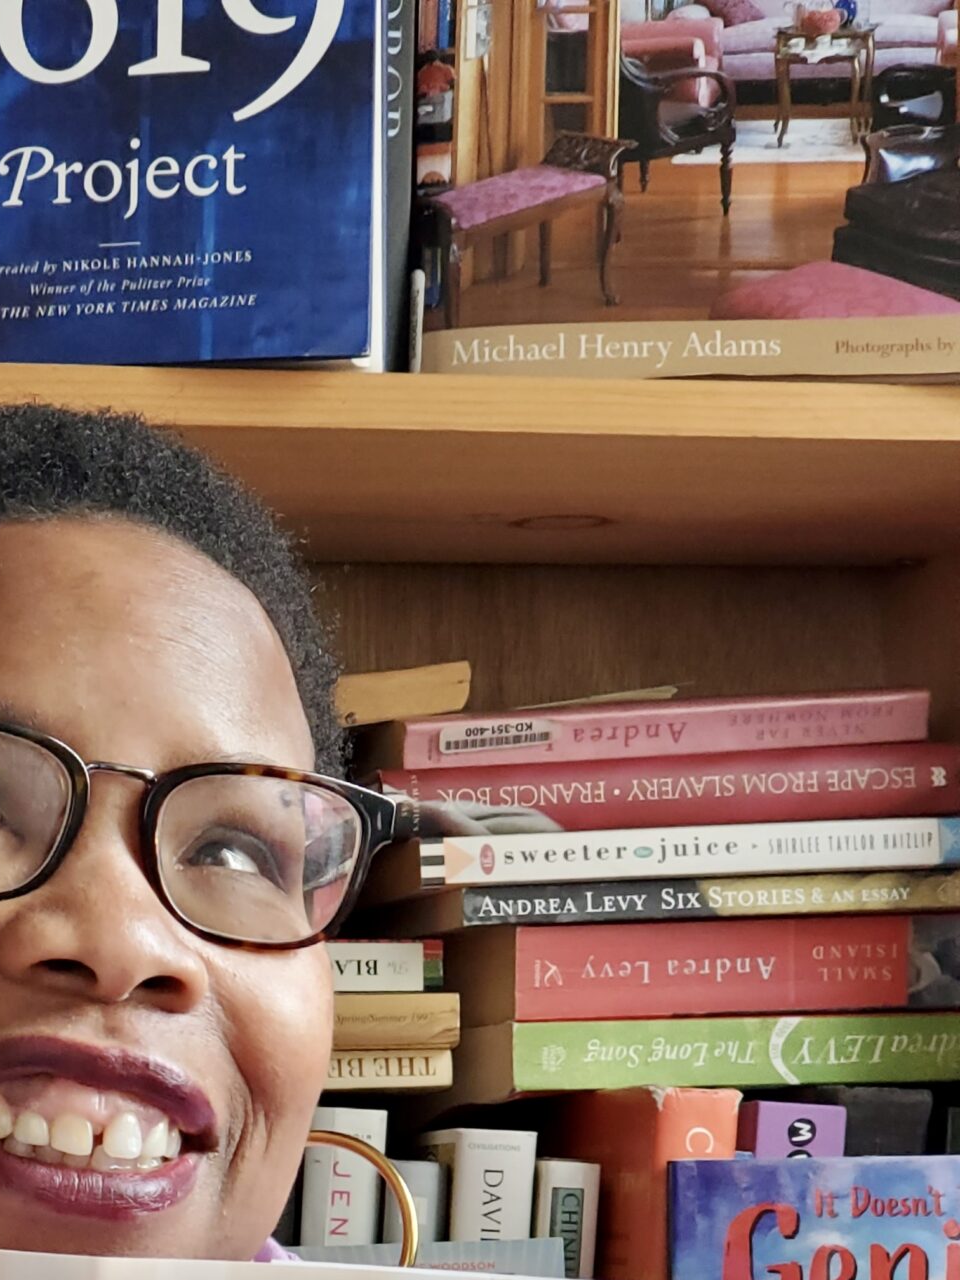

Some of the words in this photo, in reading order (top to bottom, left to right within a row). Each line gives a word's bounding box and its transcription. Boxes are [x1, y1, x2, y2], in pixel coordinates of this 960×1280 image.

[43, 261, 58, 276] by
[62, 257, 120, 272] NIKOLE
[127, 250, 253, 268] HANNAH-JONES
[30, 282, 76, 296] Winner
[80, 279, 94, 295] of
[97, 279, 117, 292] the
[121, 277, 172, 291] Pulitzer
[177, 275, 210, 288] Prize
[0, 306, 30, 319] THE
[37, 303, 70, 317] NEW
[75, 301, 115, 315] YORK
[121, 298, 168, 312] TIMES
[173, 294, 258, 310] MAGAZINE
[451, 332, 566, 367] Michael
[579, 334, 673, 368] Henry
[682, 330, 782, 358] Adams
[835, 337, 932, 358] Photographs
[937, 337, 956, 357] by
[465, 722, 533, 737] KD-351-400
[573, 723, 688, 746] Andrea
[628, 772, 735, 801] SLAVERY
[741, 769, 819, 792] FROM
[827, 767, 916, 788] ESCAPE
[436, 787, 492, 808] BOK
[499, 780, 606, 806] FRANCIS
[503, 843, 626, 865] sweeter
[655, 835, 741, 864] juice
[768, 836, 822, 855] SHIRLEE
[828, 835, 879, 852] TAYLOR
[883, 831, 934, 850] HAIZLIP
[478, 896, 577, 918] ANDREA
[585, 893, 647, 913] LEVY
[661, 891, 700, 910] SIX
[707, 886, 805, 907] STORIES
[812, 887, 825, 902] &
[832, 887, 855, 902] AN
[861, 885, 911, 901] ESSAY
[811, 944, 899, 959] ISLAND
[580, 957, 651, 984] Levy
[667, 955, 776, 981] Andrea
[817, 966, 892, 982] SMALL
[584, 1039, 643, 1065] Song
[649, 1038, 708, 1065] Long
[716, 1040, 756, 1065] The
[792, 1034, 884, 1065] LEVY
[374, 1057, 436, 1077] THE
[815, 1188, 839, 1217] It
[851, 1185, 946, 1218] Doesn't
